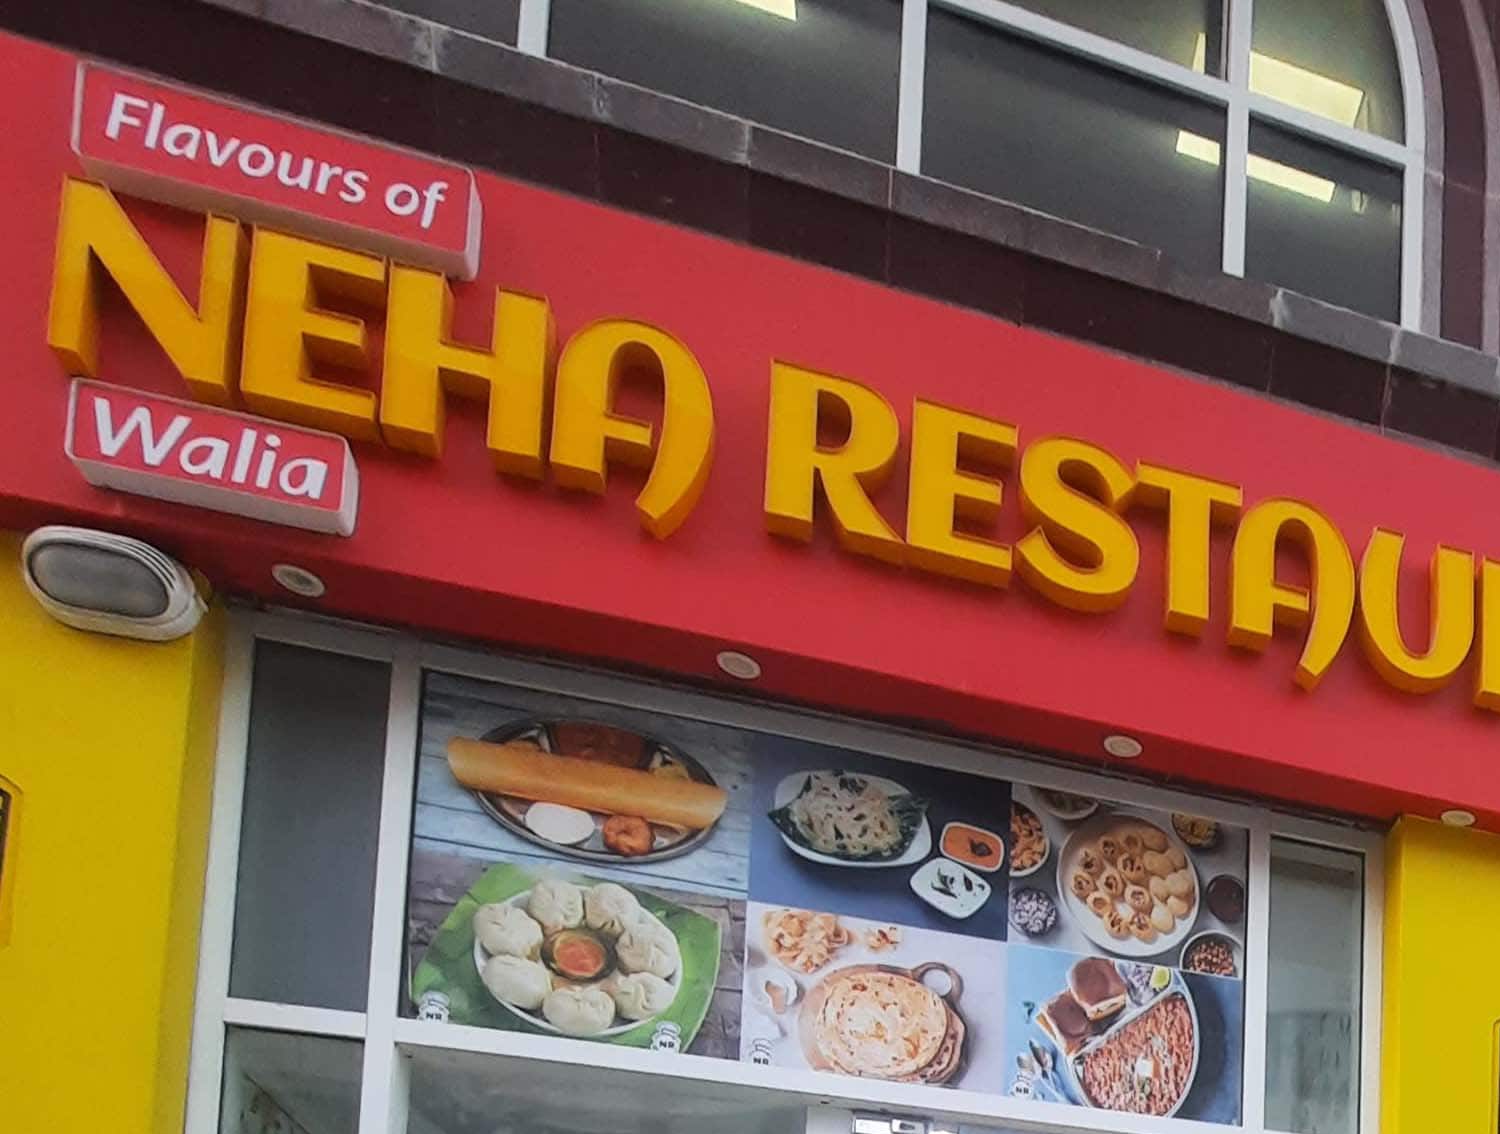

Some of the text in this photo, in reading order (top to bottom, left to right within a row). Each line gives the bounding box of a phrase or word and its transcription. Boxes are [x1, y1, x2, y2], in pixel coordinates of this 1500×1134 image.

[104, 92, 449, 229] Flavours of
[48, 173, 714, 540] NEHA
[94, 397, 329, 499] Walia
